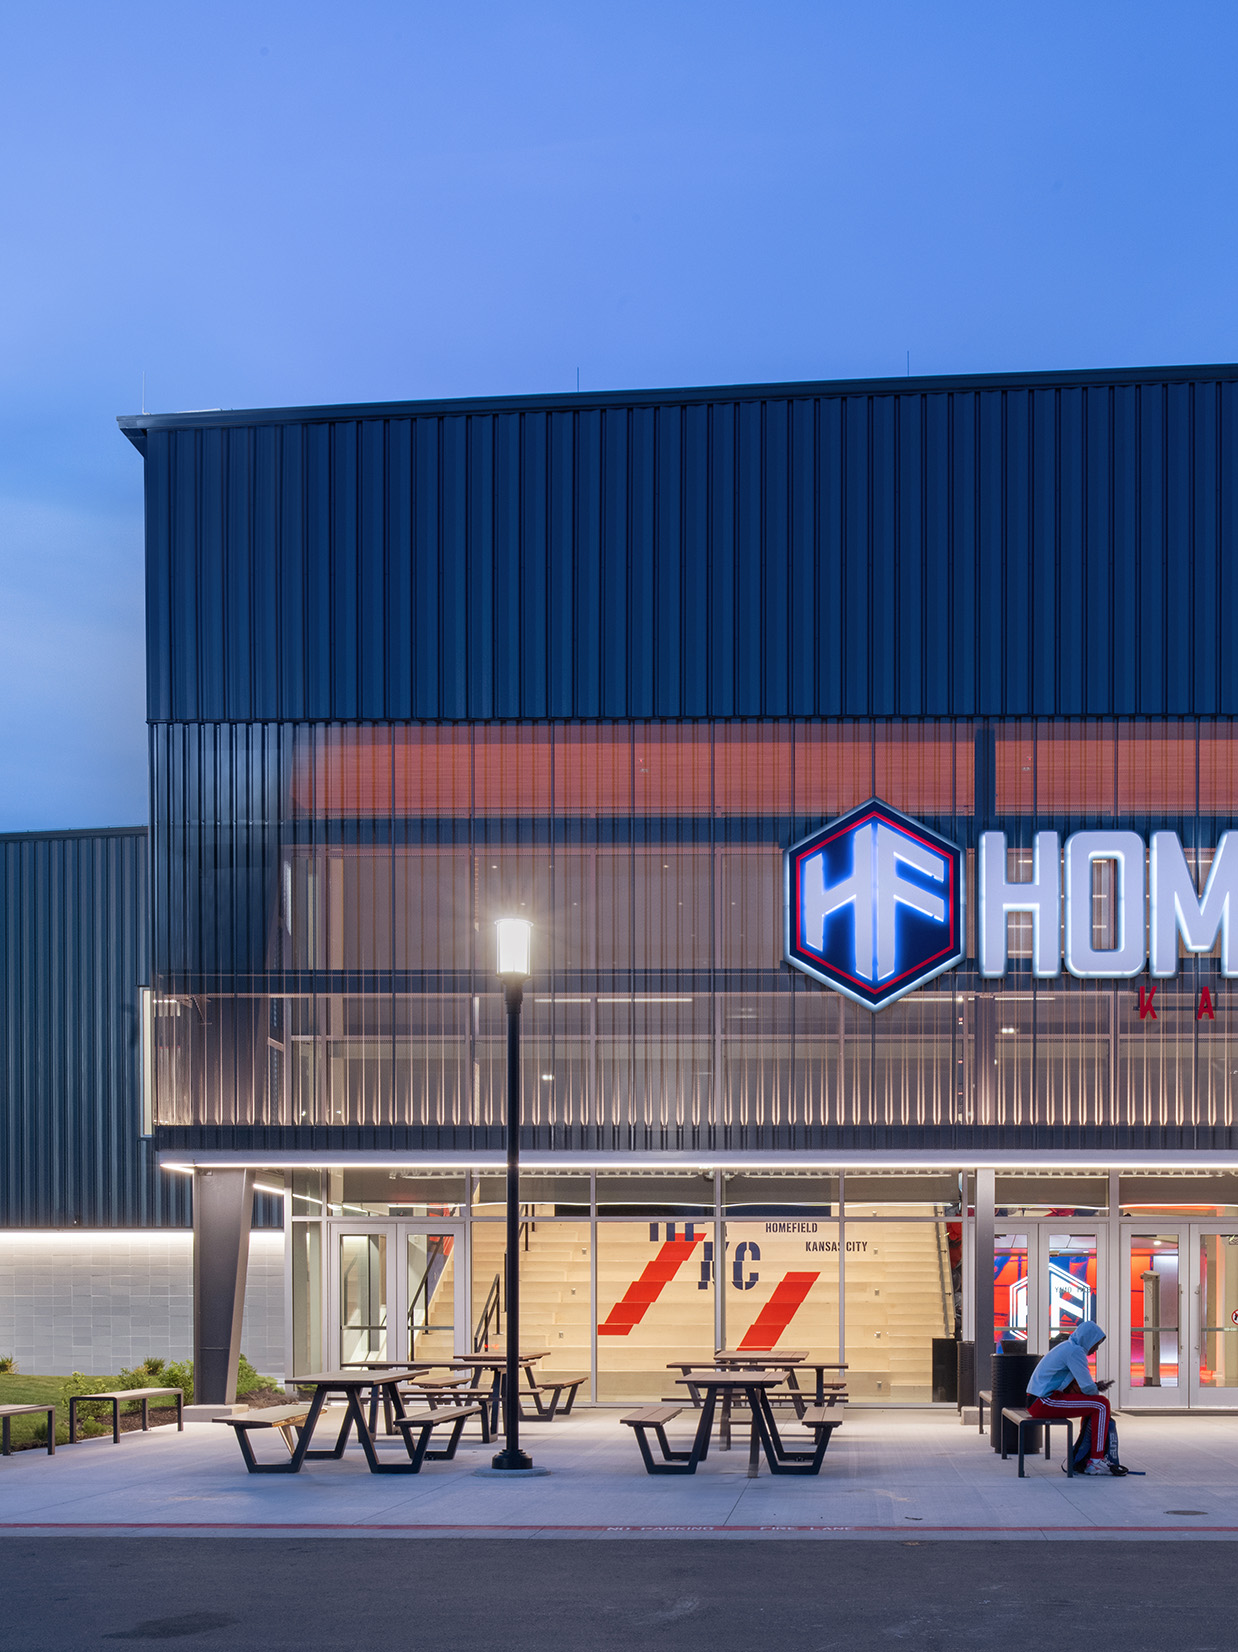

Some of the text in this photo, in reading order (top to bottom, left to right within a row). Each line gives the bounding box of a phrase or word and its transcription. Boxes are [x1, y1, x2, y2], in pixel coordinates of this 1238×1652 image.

[805, 823, 945, 981] HF
[765, 1222, 818, 1233] HOMEFIELD
[846, 1241, 868, 1252] CITY
